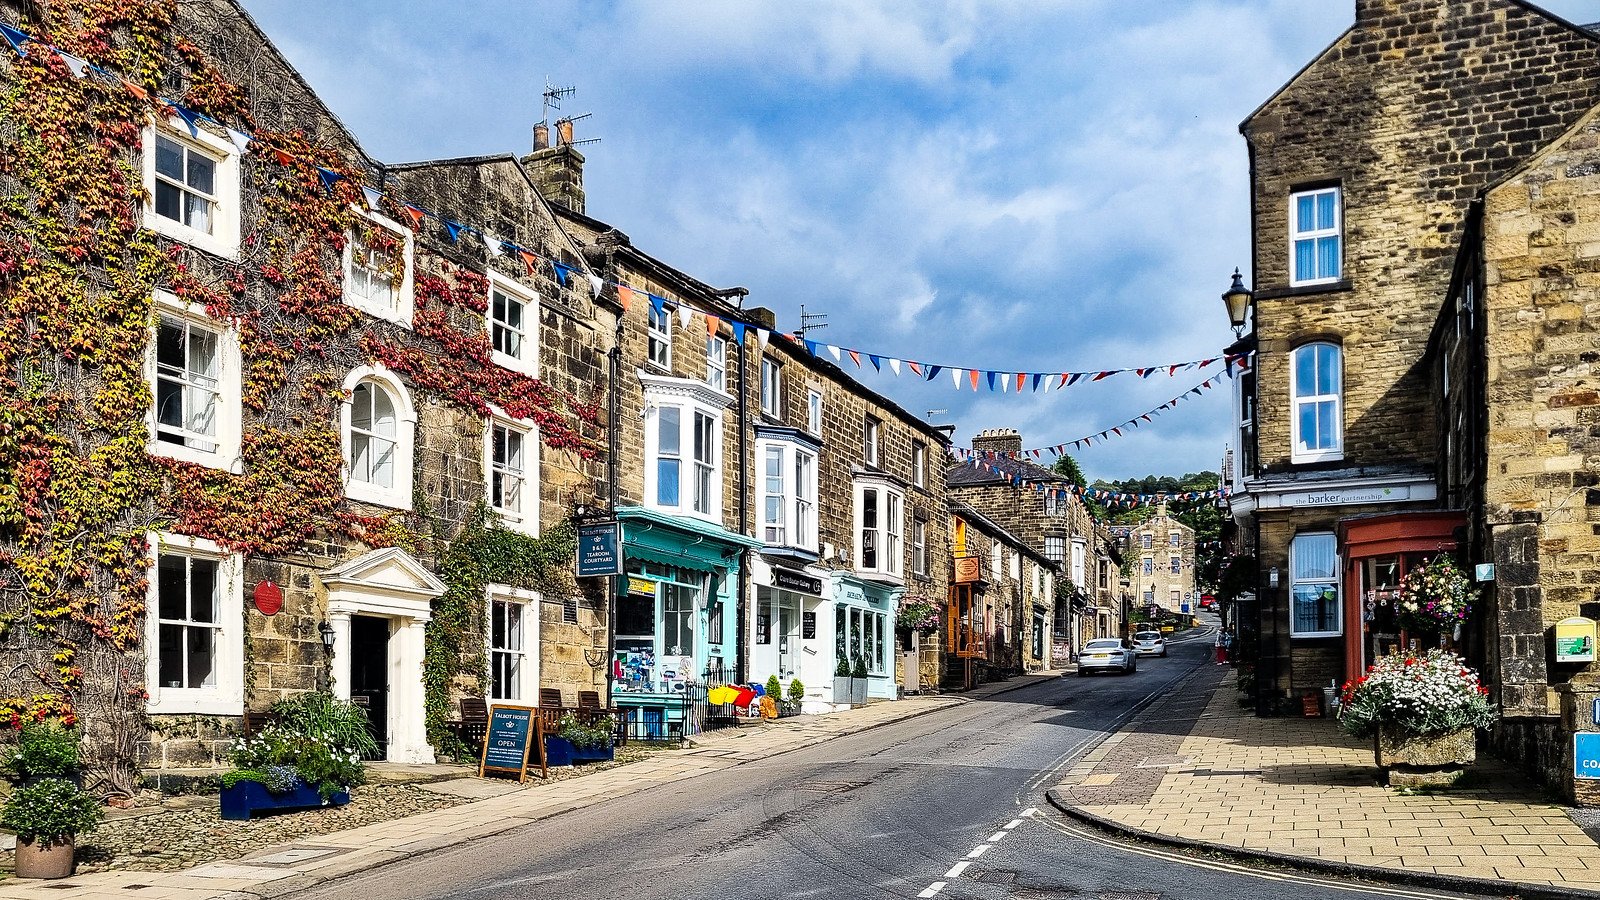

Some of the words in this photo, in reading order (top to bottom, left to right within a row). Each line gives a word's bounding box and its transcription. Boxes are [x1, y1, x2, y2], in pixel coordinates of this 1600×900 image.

[1308, 493, 1340, 504] barker
[1341, 493, 1383, 503] partnership
[497, 739, 516, 747] OPEN
[1582, 759, 1600, 769] CO
